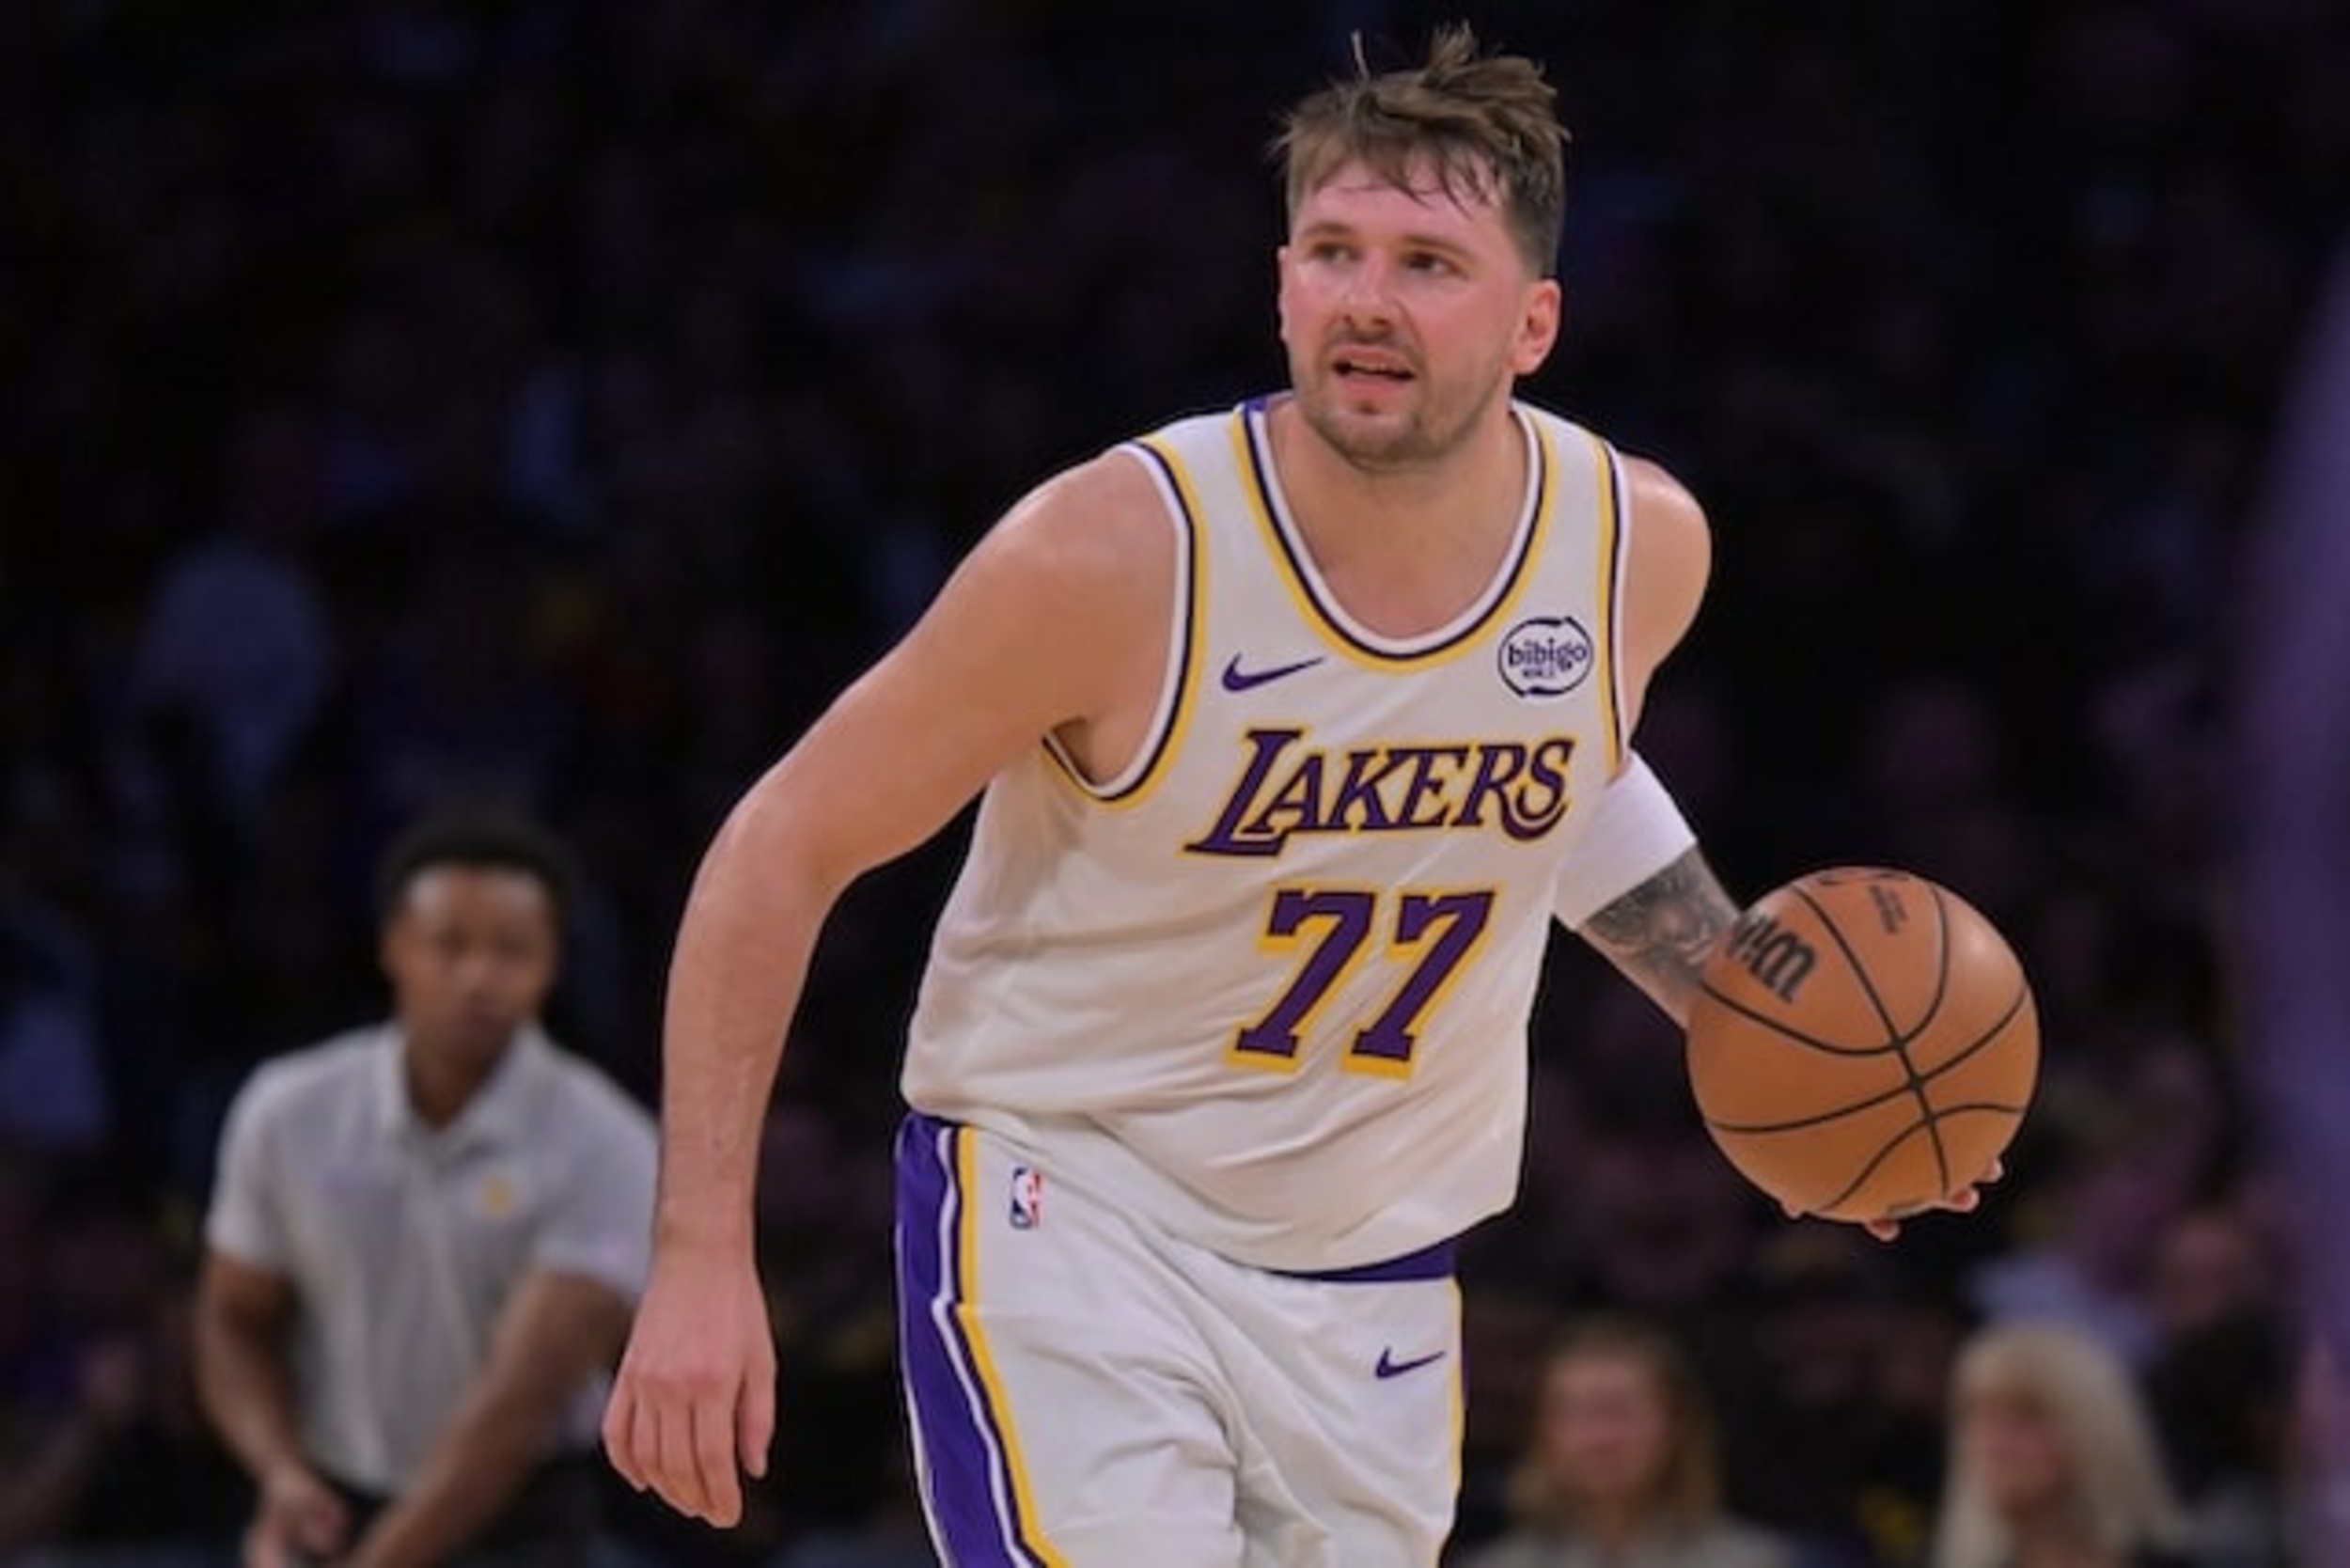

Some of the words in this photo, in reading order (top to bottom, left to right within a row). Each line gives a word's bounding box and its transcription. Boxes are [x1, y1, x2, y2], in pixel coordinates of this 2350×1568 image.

[1507, 637, 1589, 673] bibigo
[1180, 725, 1577, 860] LAKERS
[1226, 883, 1498, 1079] 77
